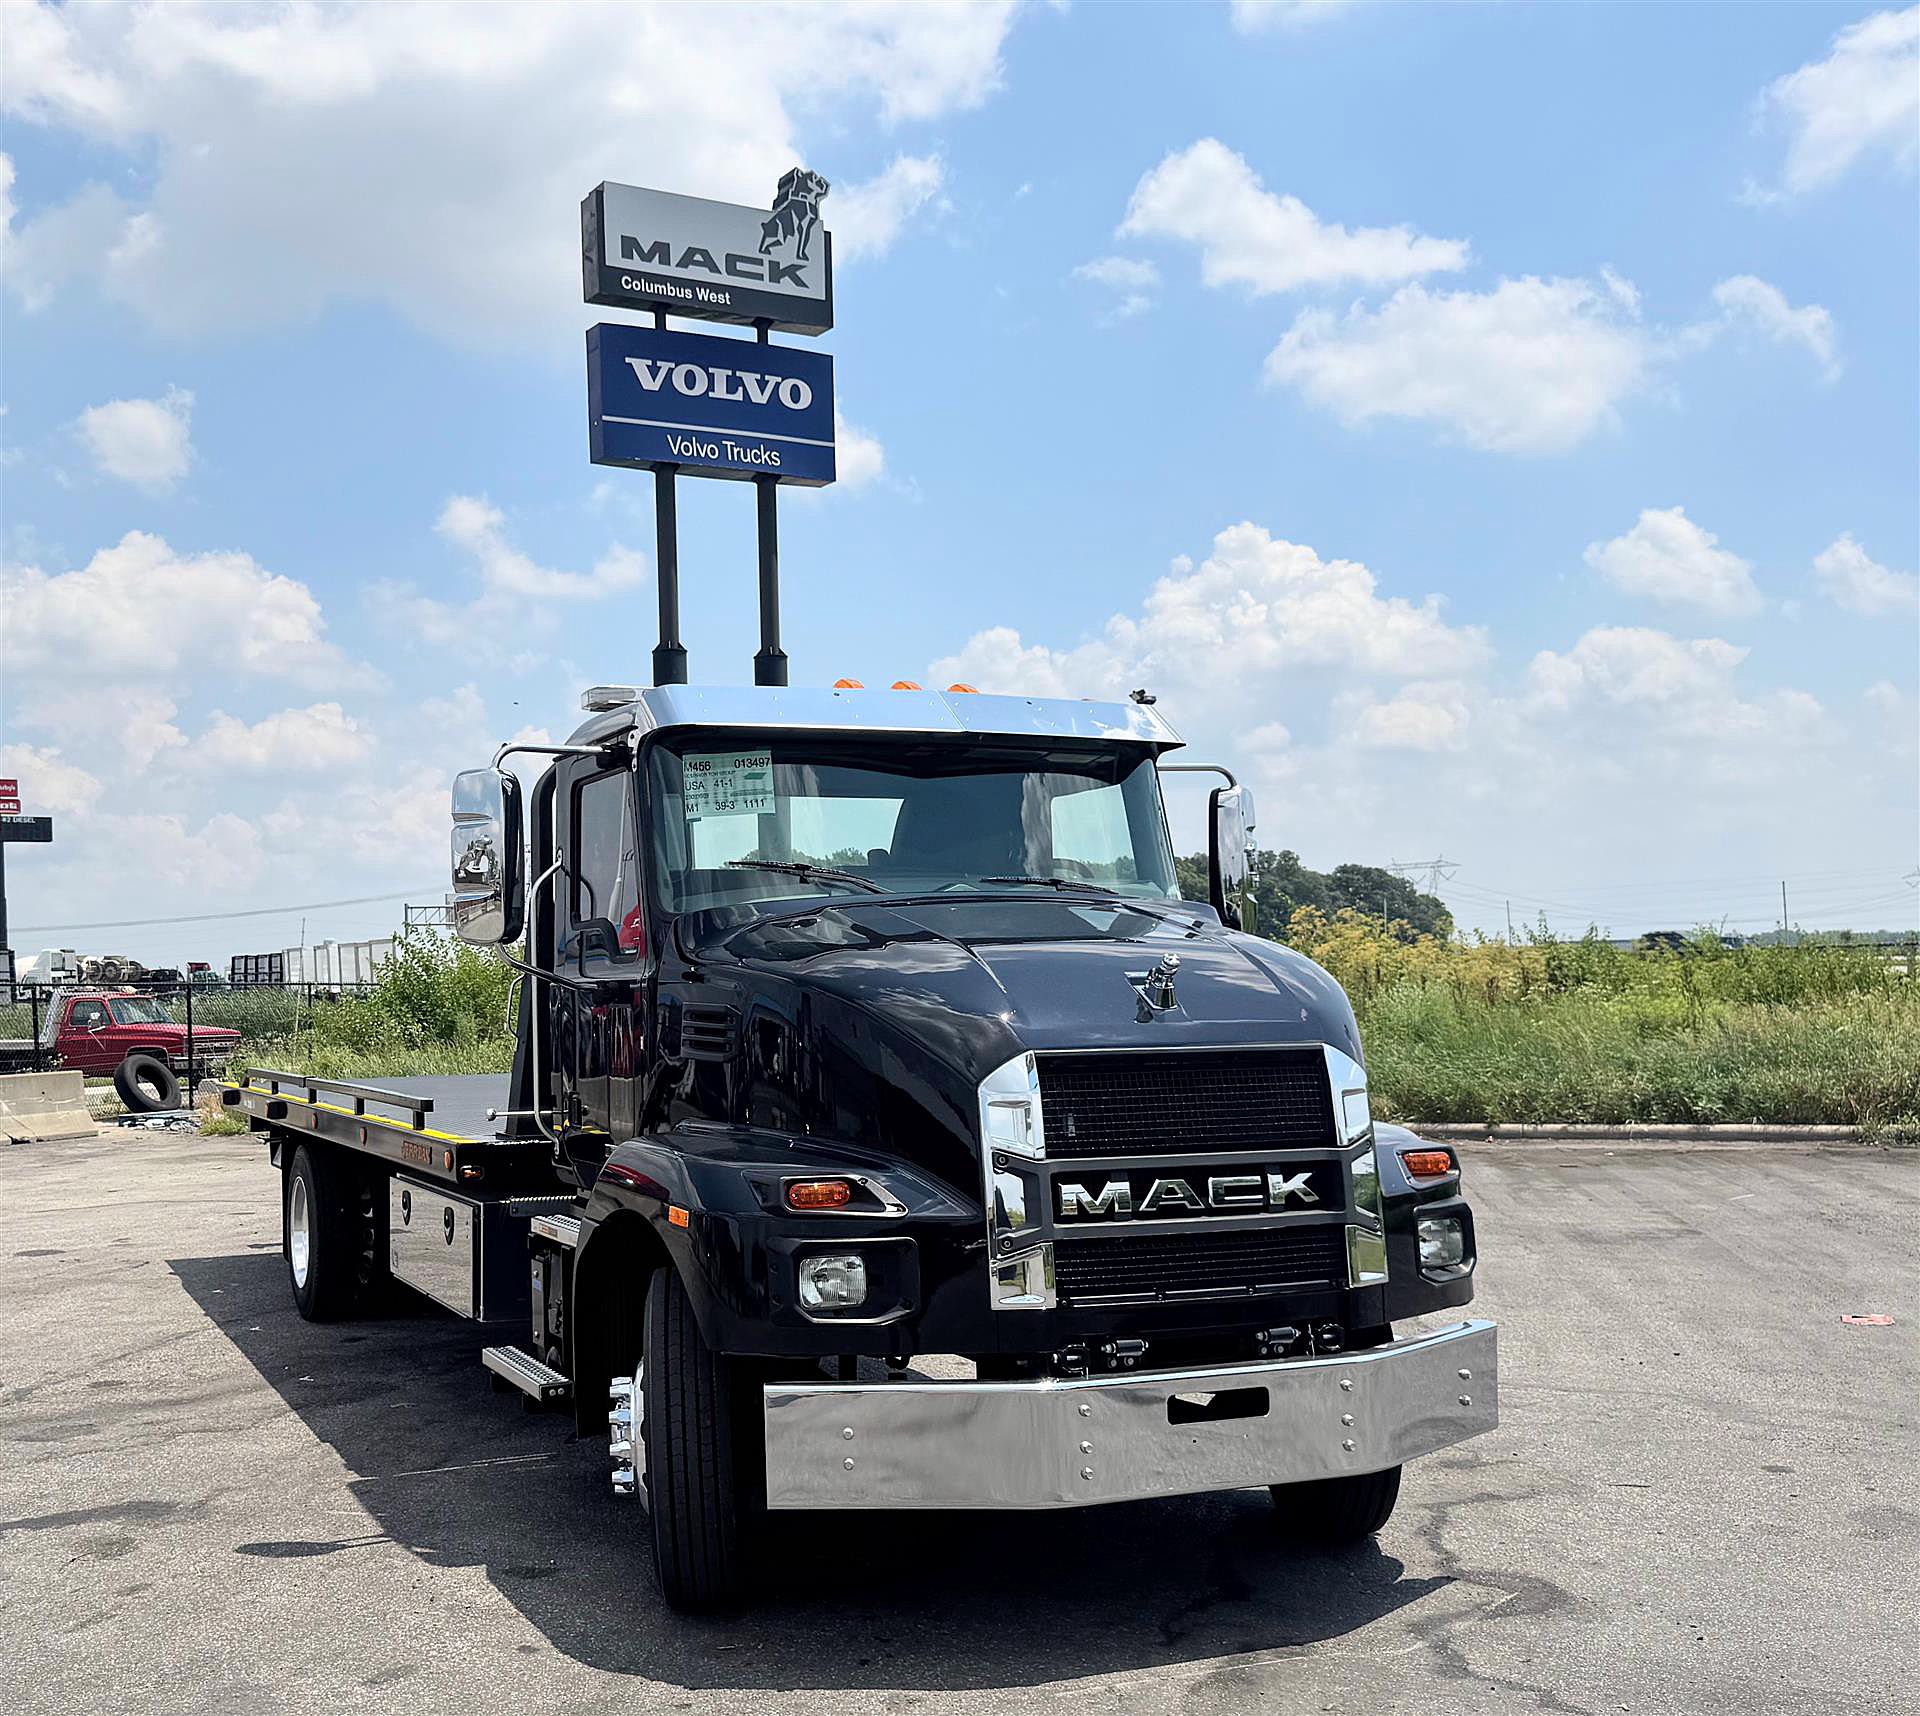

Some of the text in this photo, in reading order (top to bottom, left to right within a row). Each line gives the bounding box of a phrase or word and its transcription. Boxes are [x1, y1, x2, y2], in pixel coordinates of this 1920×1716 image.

[620, 234, 810, 289] MACK
[621, 275, 731, 305] Columbus West
[624, 356, 812, 410] VOLVO
[666, 434, 781, 466] Volvo Trucks
[734, 757, 770, 769] 013497
[685, 779, 733, 791] USA 41-1
[12, 816, 36, 824] DIESEL
[686, 803, 699, 813] M1
[715, 800, 735, 811] 39-3
[1057, 1172, 1320, 1216] MACK
